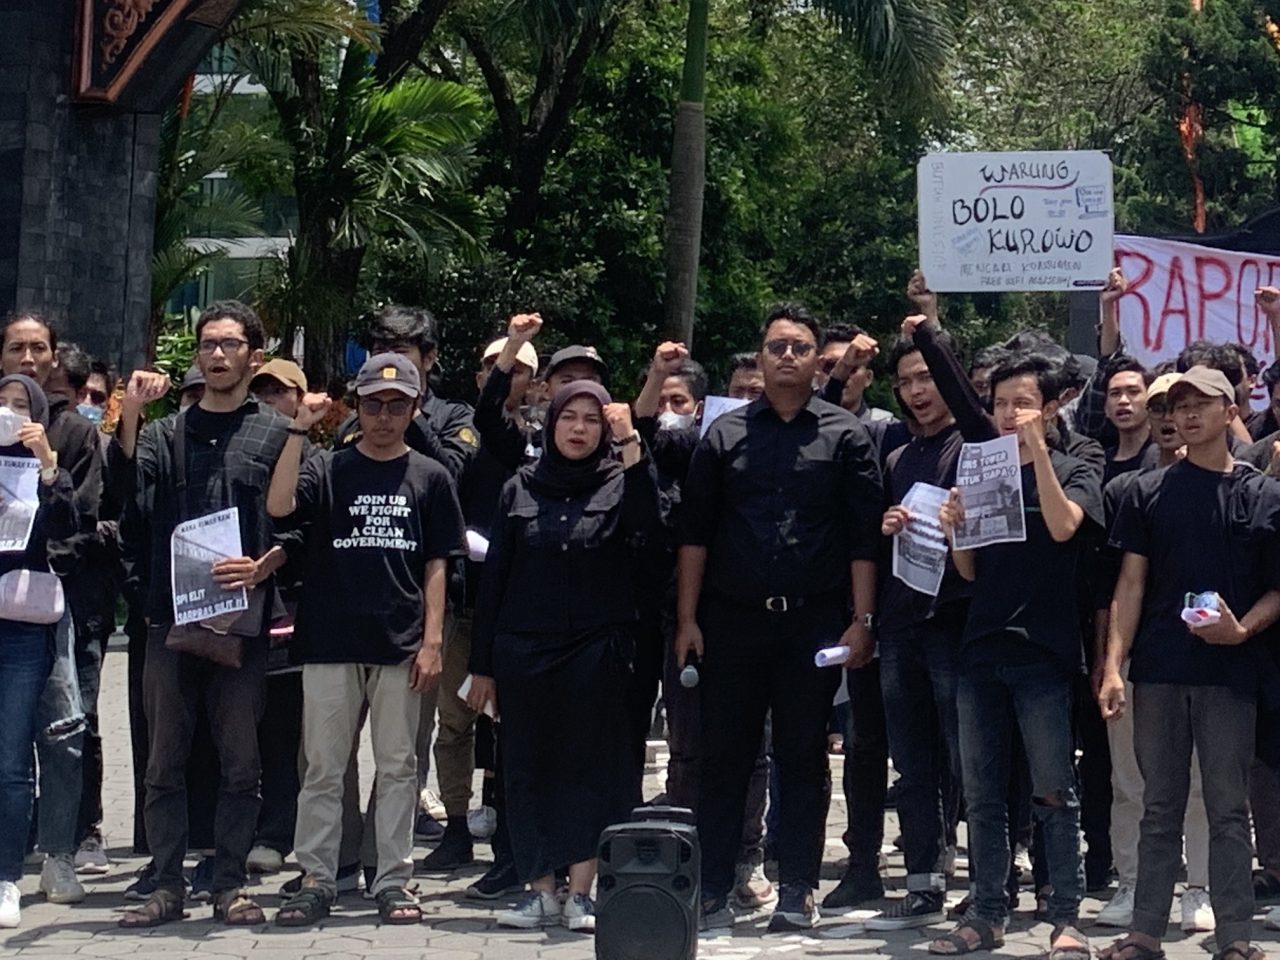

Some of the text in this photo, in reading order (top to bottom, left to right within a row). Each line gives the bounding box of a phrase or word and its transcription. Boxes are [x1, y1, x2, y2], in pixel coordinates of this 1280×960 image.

[979, 160, 1069, 183] WARUNG
[952, 195, 1024, 225] BOLO
[988, 228, 1093, 254] KUROWO
[354, 495, 407, 505] JOIN US
[348, 505, 412, 517] WE FIGHT
[365, 515, 391, 526] FOR
[350, 526, 405, 538] A CLEAN
[332, 537, 418, 551] GOVERNMENT
[176, 593, 188, 605] SPI
